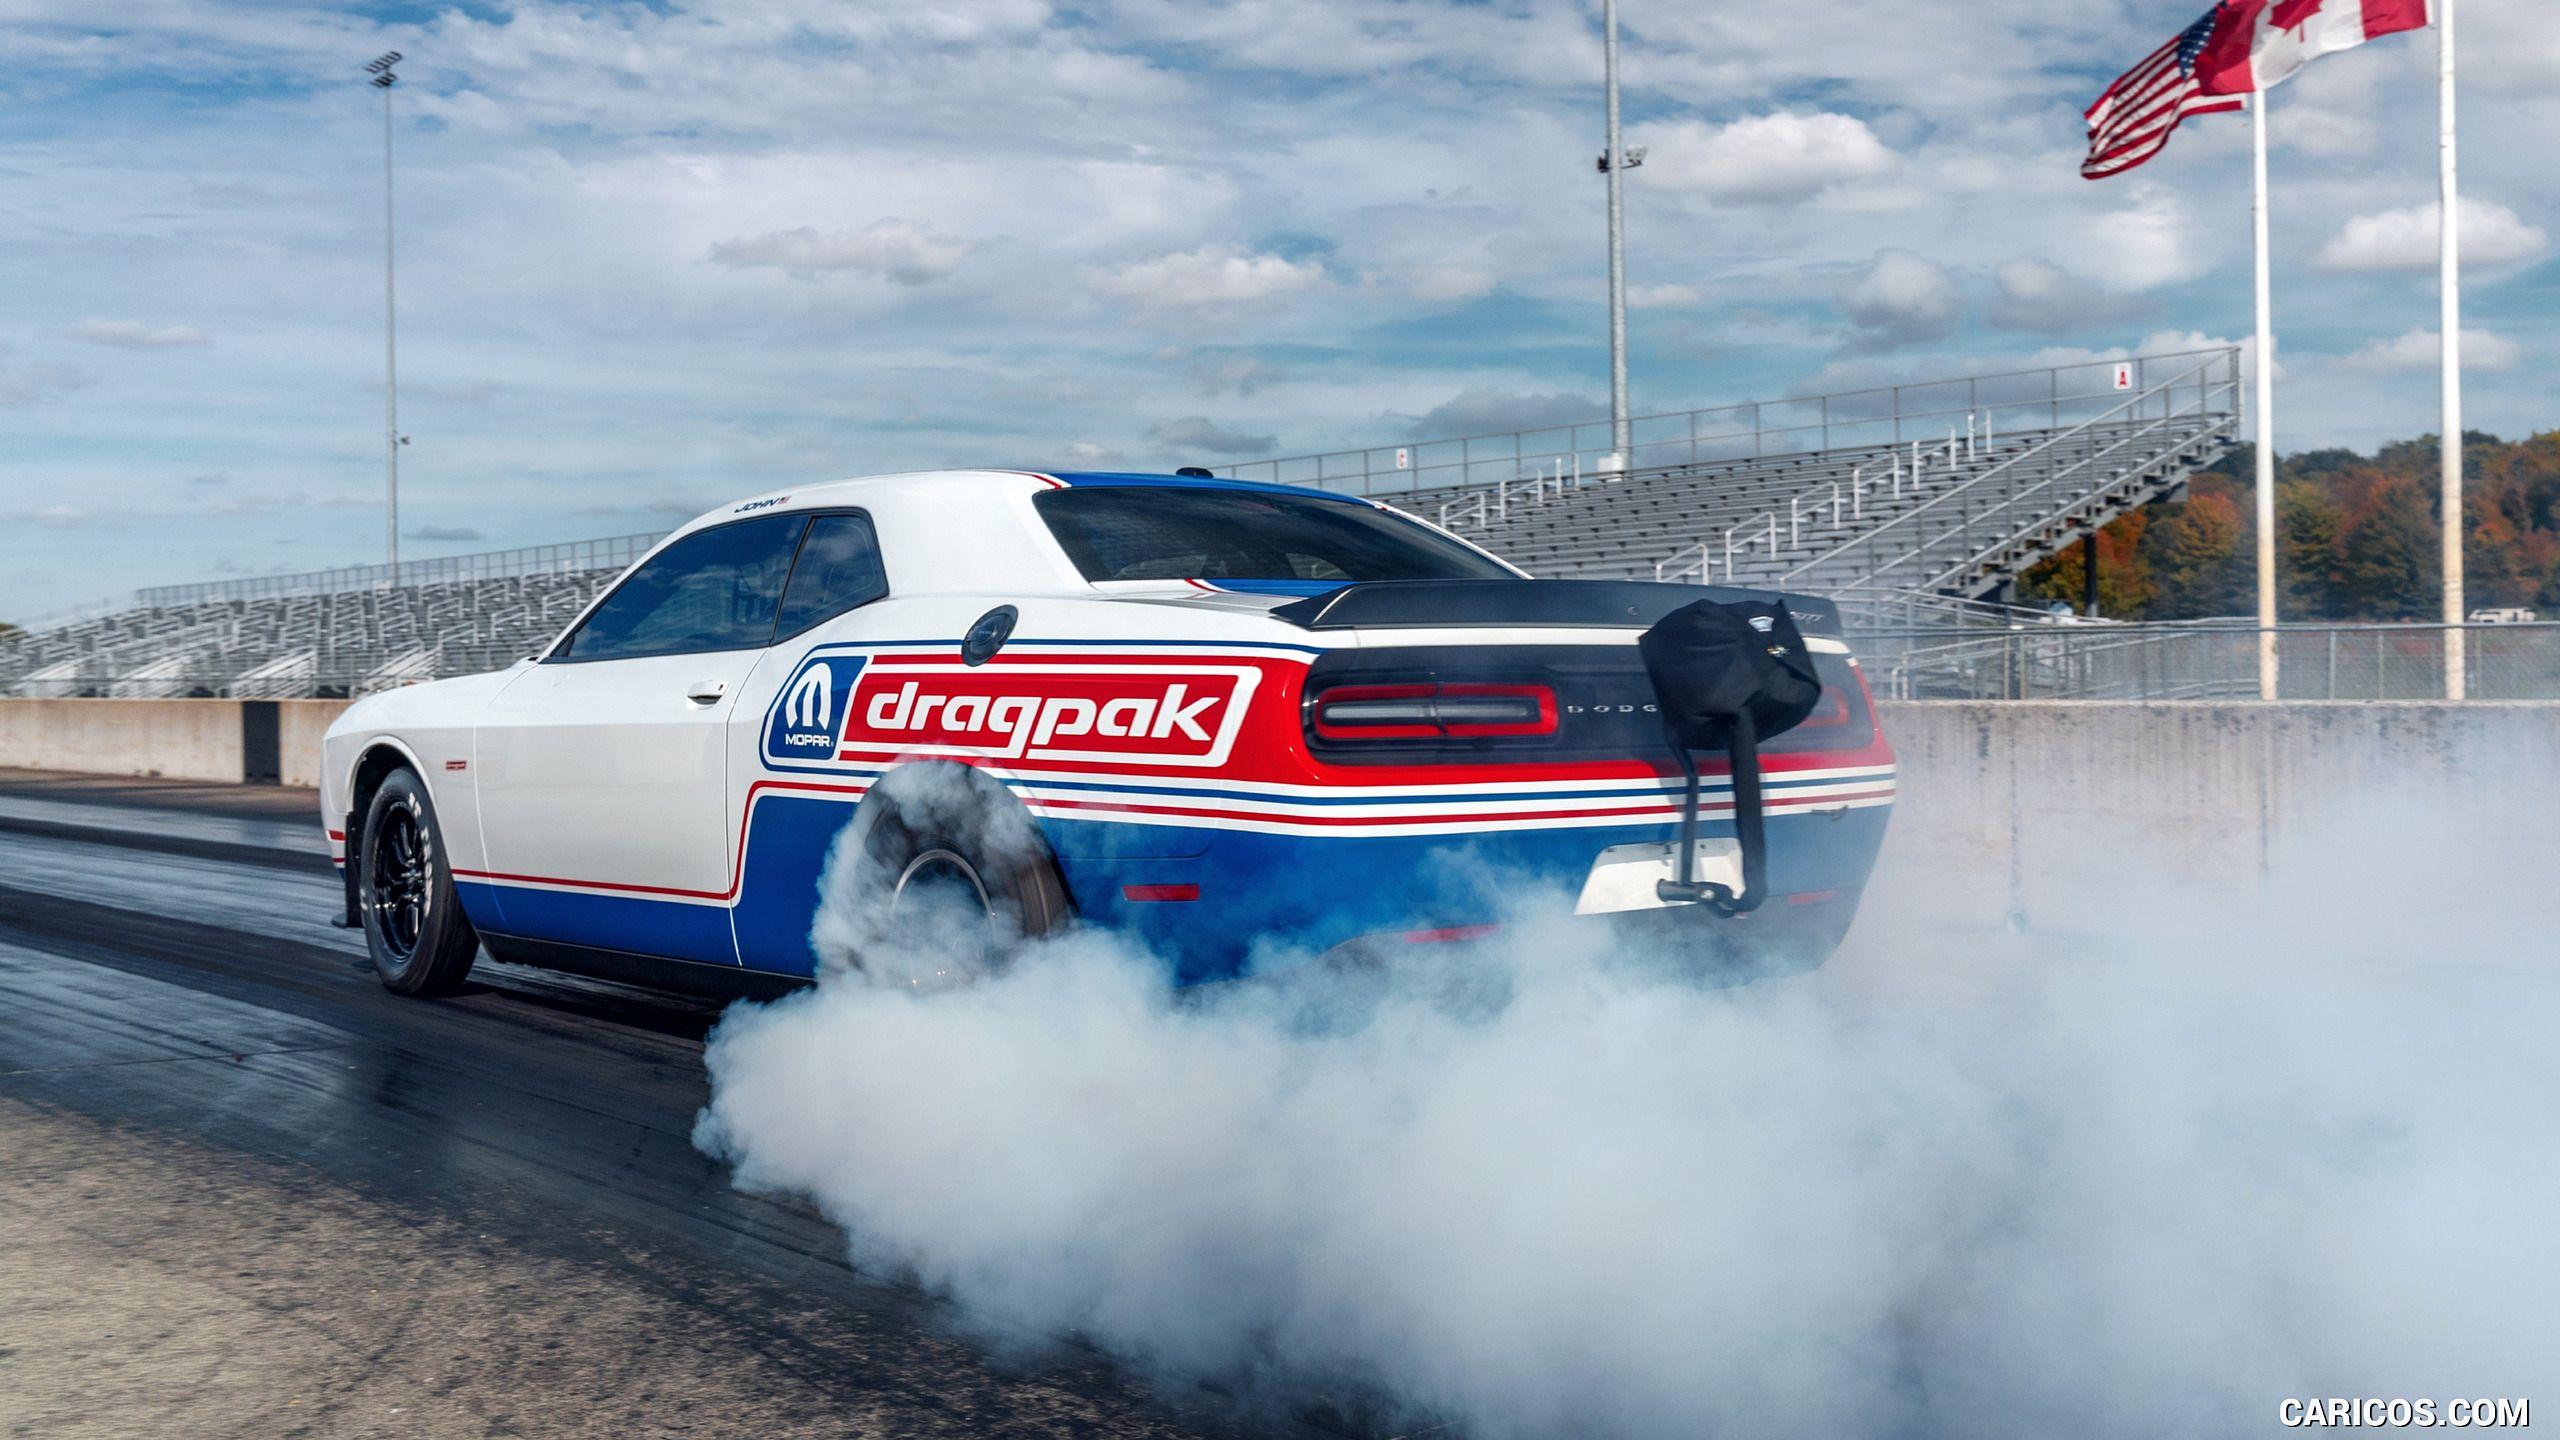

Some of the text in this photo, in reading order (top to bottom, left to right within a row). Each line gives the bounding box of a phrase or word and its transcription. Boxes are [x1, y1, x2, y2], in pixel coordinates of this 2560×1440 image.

[734, 497, 780, 513] JOHN
[1567, 704, 1658, 714] DODG
[866, 682, 1220, 756] dragpak
[785, 733, 830, 747] MOPAR
